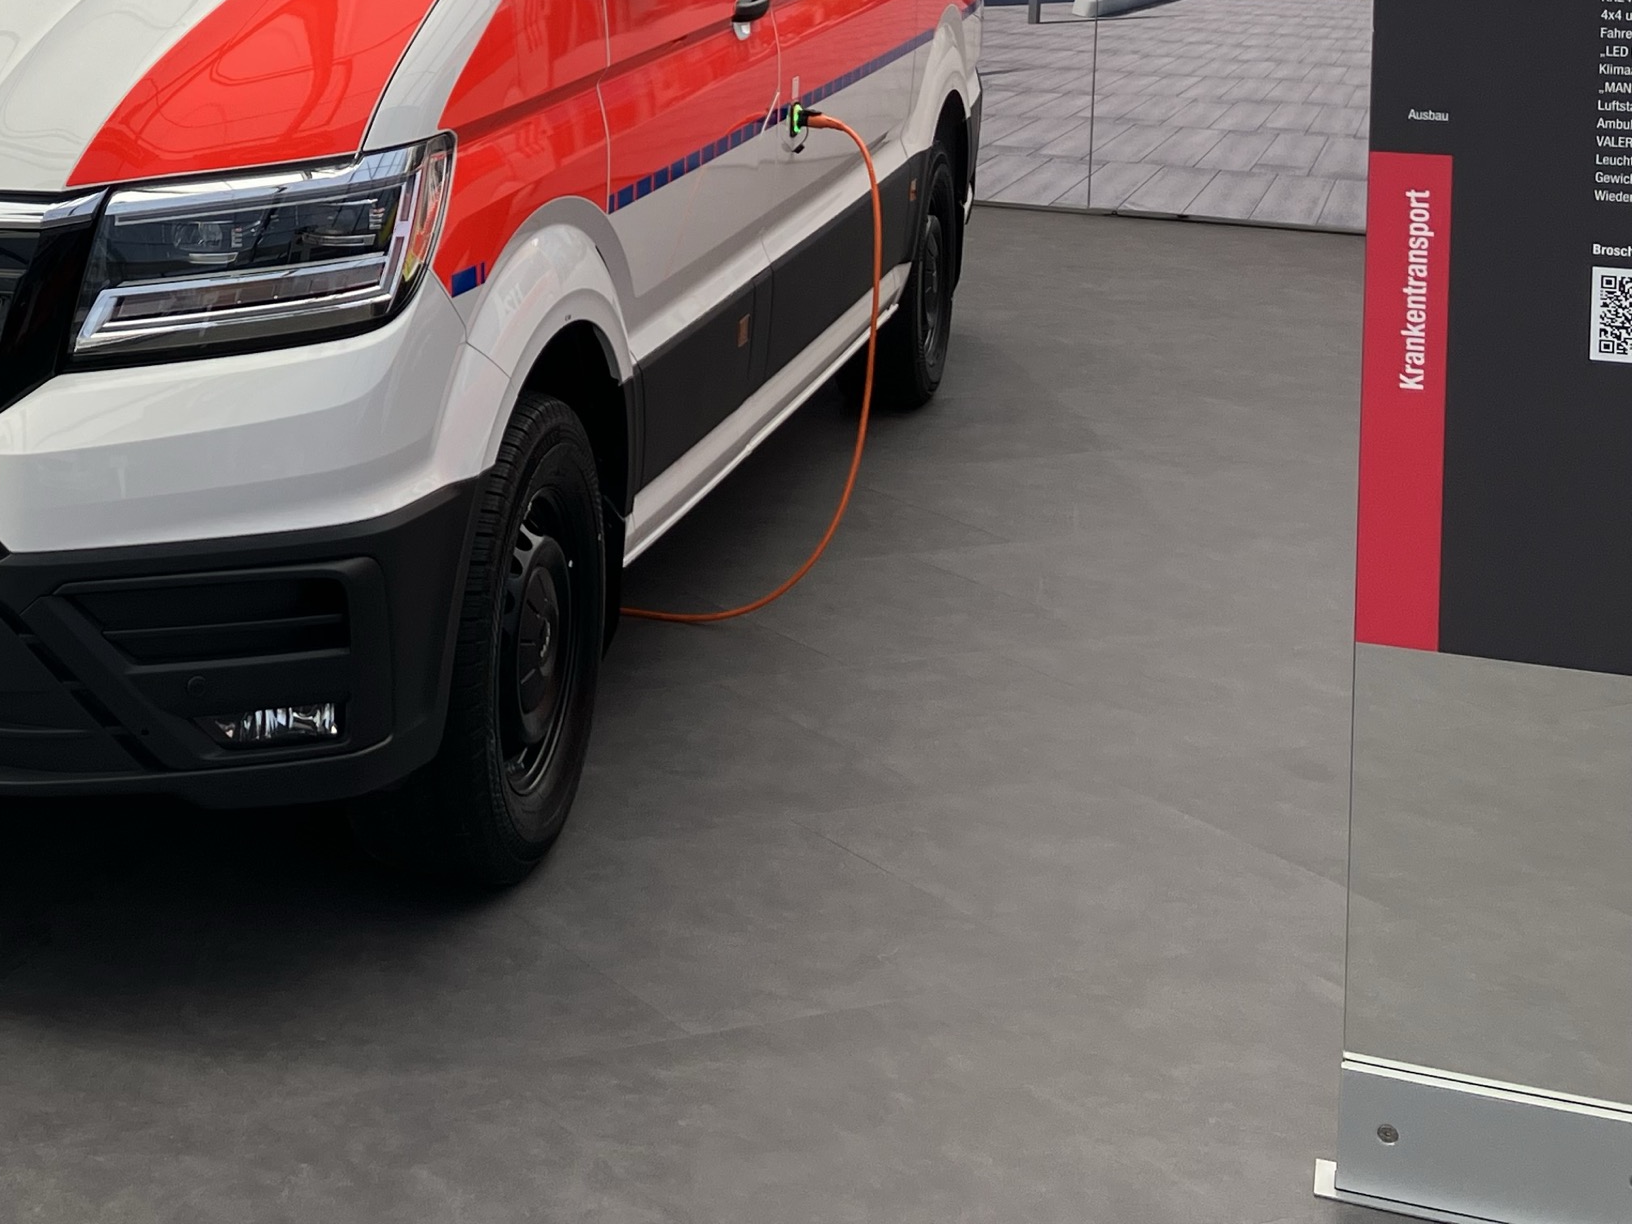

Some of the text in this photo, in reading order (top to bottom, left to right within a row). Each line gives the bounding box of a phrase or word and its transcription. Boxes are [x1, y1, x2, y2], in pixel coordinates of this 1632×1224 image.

[1601, 10, 1622, 21] 4x4
[1408, 109, 1448, 121] Ausbau
[1399, 190, 1434, 390] Krankentransport
